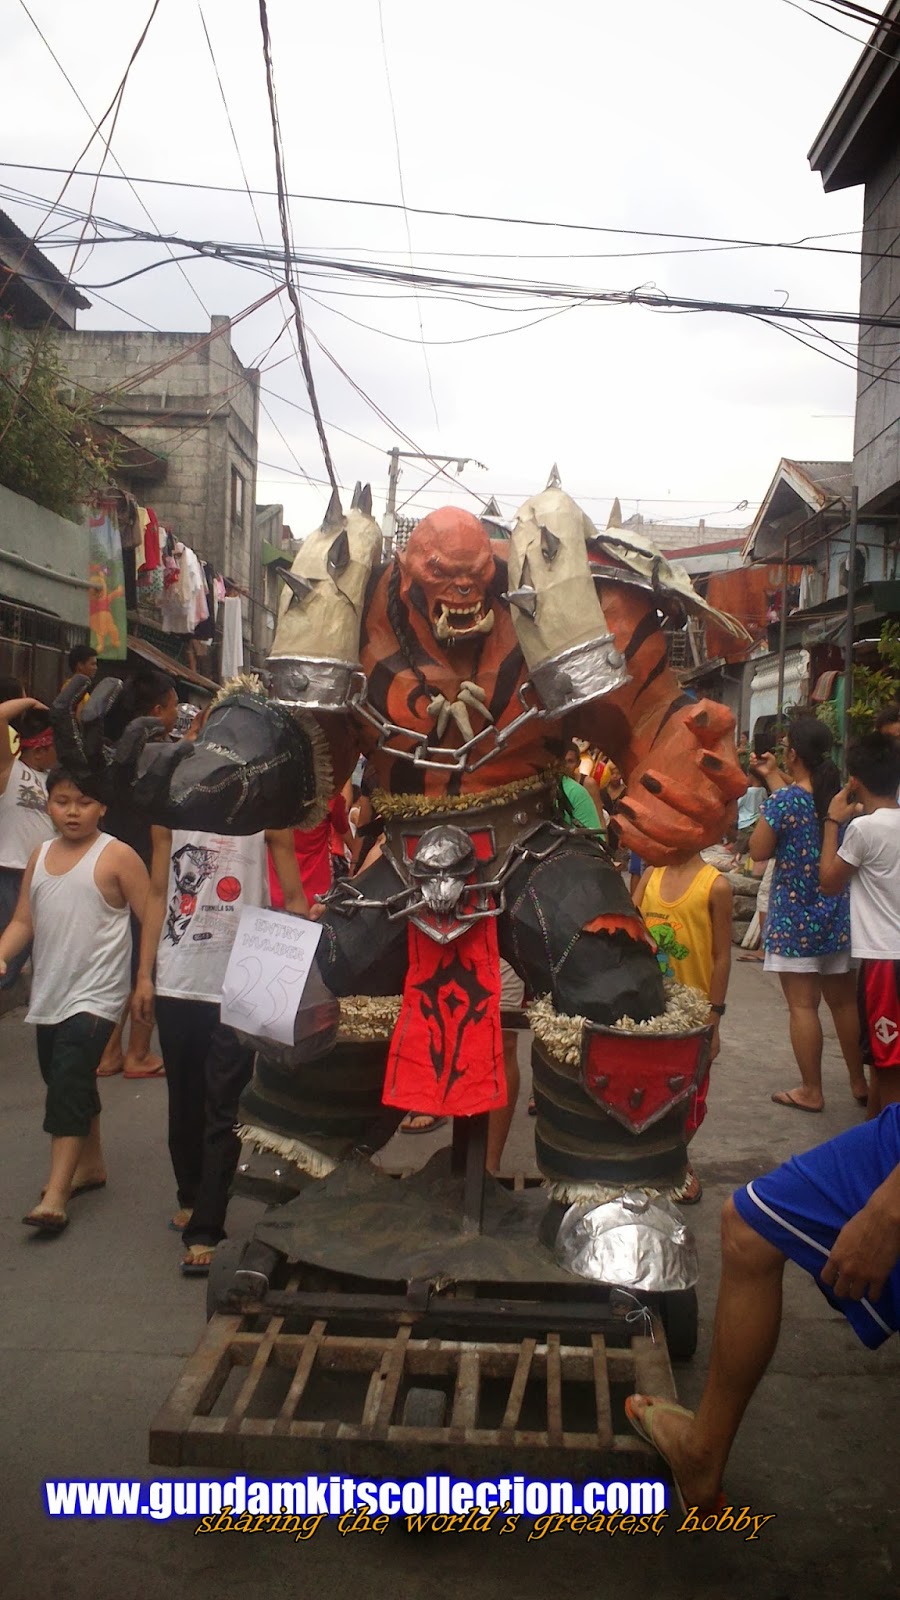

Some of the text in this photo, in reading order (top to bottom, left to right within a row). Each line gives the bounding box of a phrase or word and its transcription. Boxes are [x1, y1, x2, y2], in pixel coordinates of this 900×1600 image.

[254, 918, 305, 941] ENTRY
[242, 932, 305, 961] NUMBER
[226, 956, 305, 1028] 25
